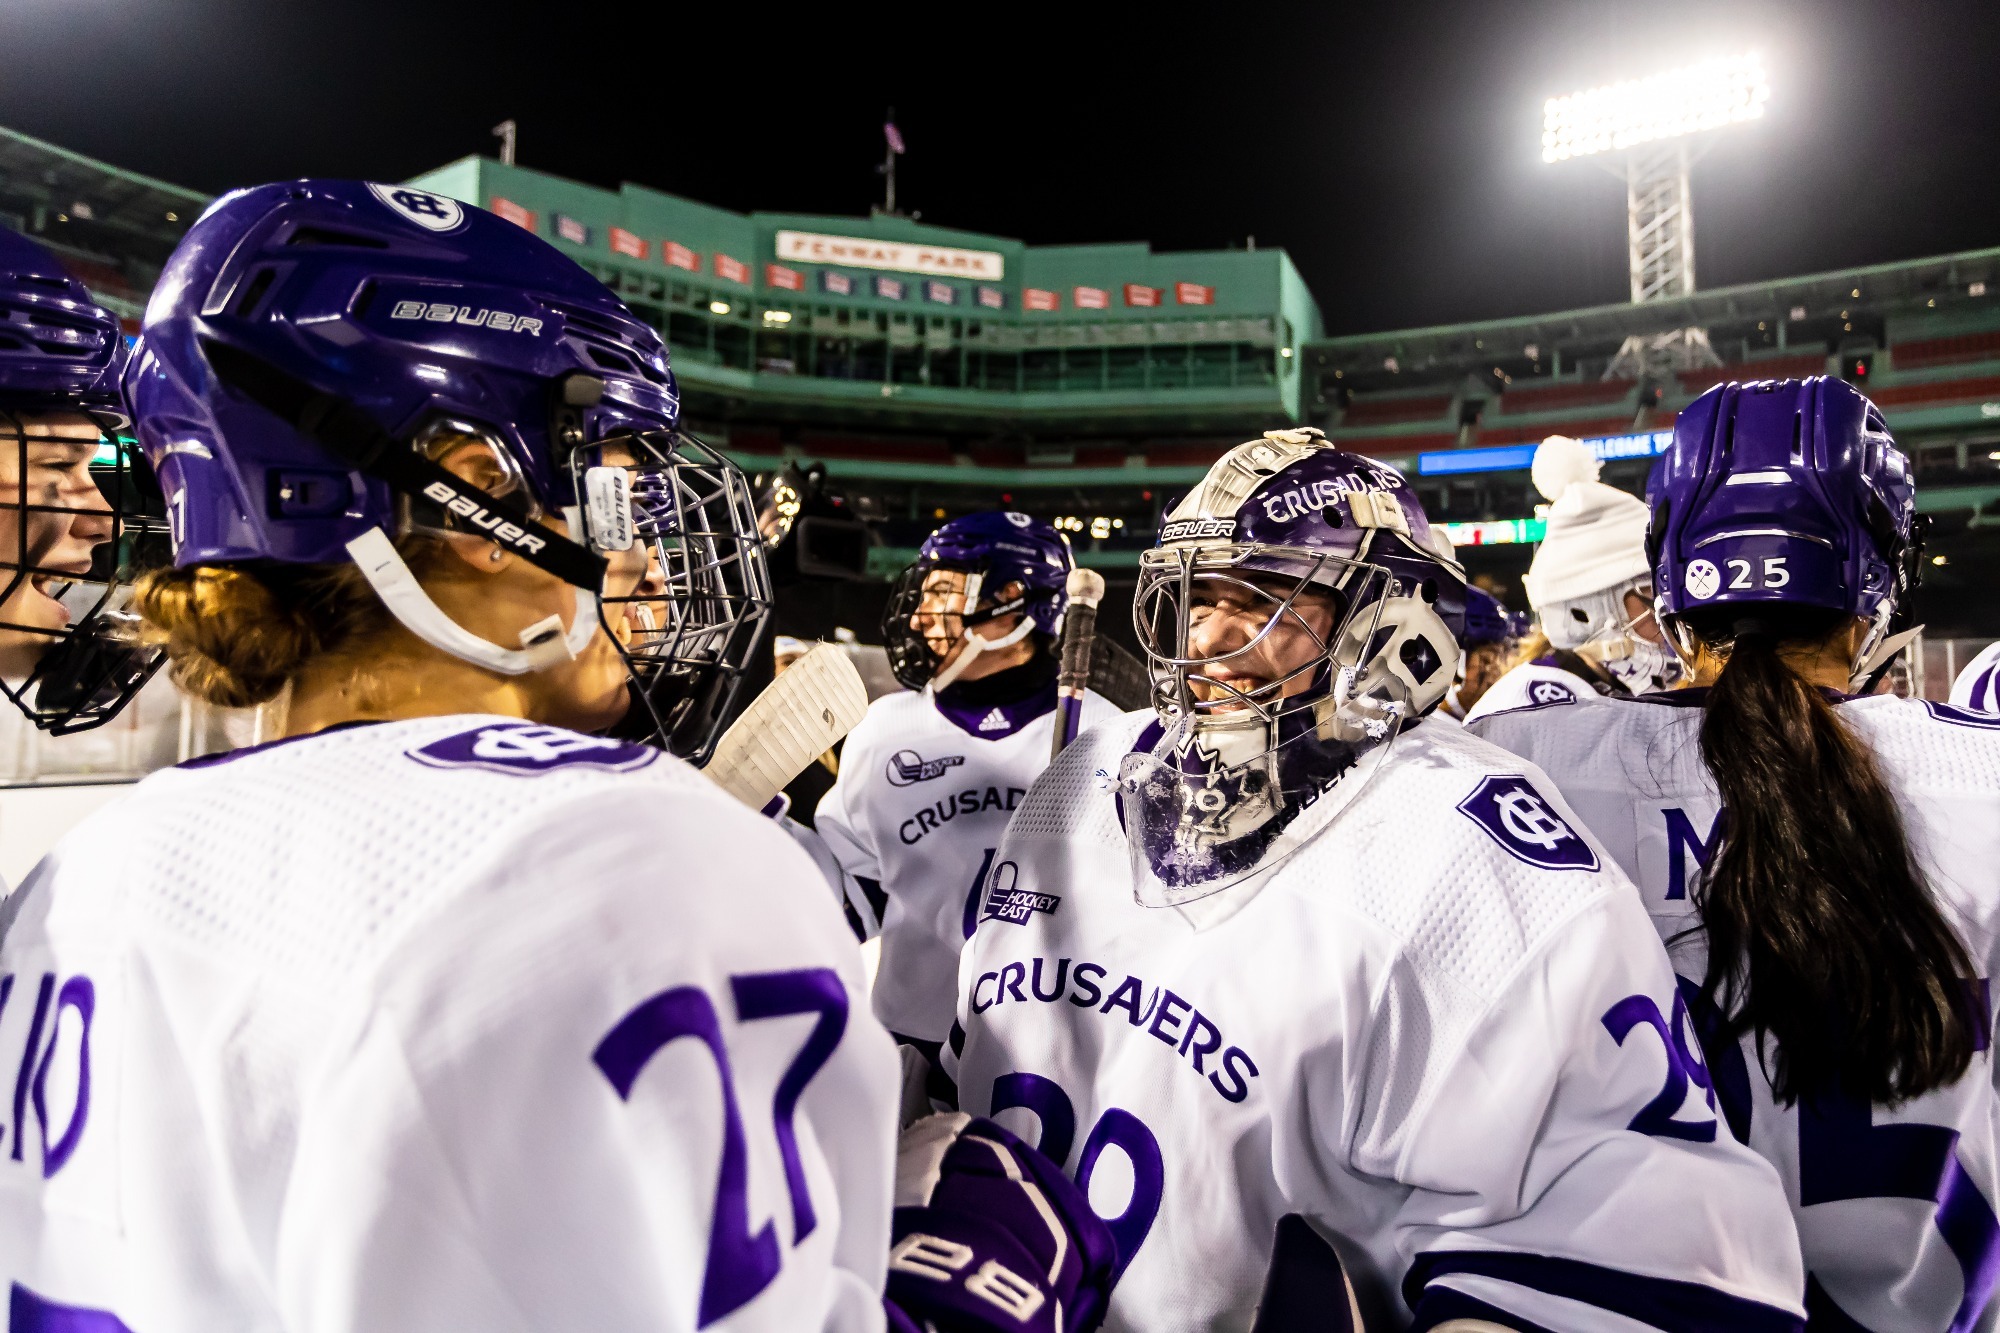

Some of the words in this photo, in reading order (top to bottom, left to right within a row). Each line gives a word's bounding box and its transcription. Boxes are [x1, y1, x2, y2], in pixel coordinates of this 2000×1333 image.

[793, 239, 900, 260] FENWAY
[918, 251, 985, 271] PARK
[1583, 434, 1651, 459] ELCOME
[1727, 557, 1790, 589] 25
[999, 904, 1031, 920] EAST
[1006, 891, 1057, 911] HOCKEY
[590, 966, 850, 1333] 27
